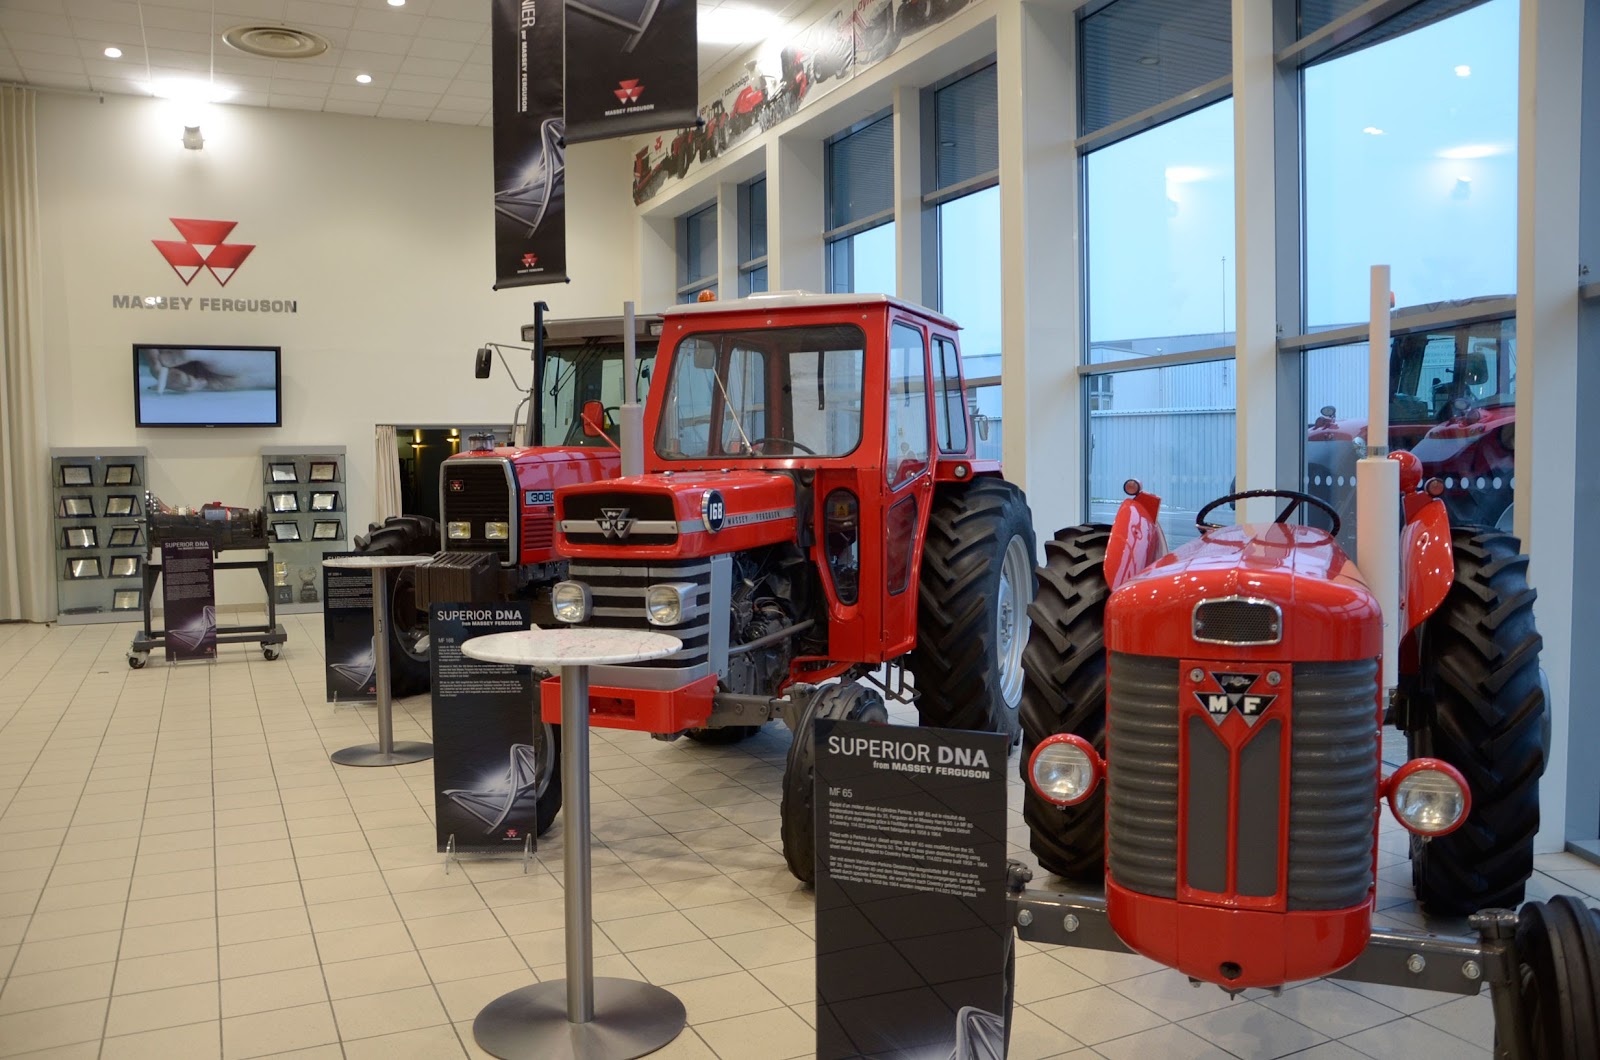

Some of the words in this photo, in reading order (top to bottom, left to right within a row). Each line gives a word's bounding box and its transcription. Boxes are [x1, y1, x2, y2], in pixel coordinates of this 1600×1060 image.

[200, 298, 297, 313] FERGUSON
[437, 610, 492, 621] SUPERIOR
[496, 610, 522, 620] DNA
[828, 736, 930, 762] SUPERIOR
[938, 746, 989, 768] DNA
[873, 760, 890, 770] from
[892, 762, 933, 774] MASSEY
[936, 766, 990, 779] FERGUSON
[829, 787, 841, 796] MF
[842, 788, 853, 798] 65
